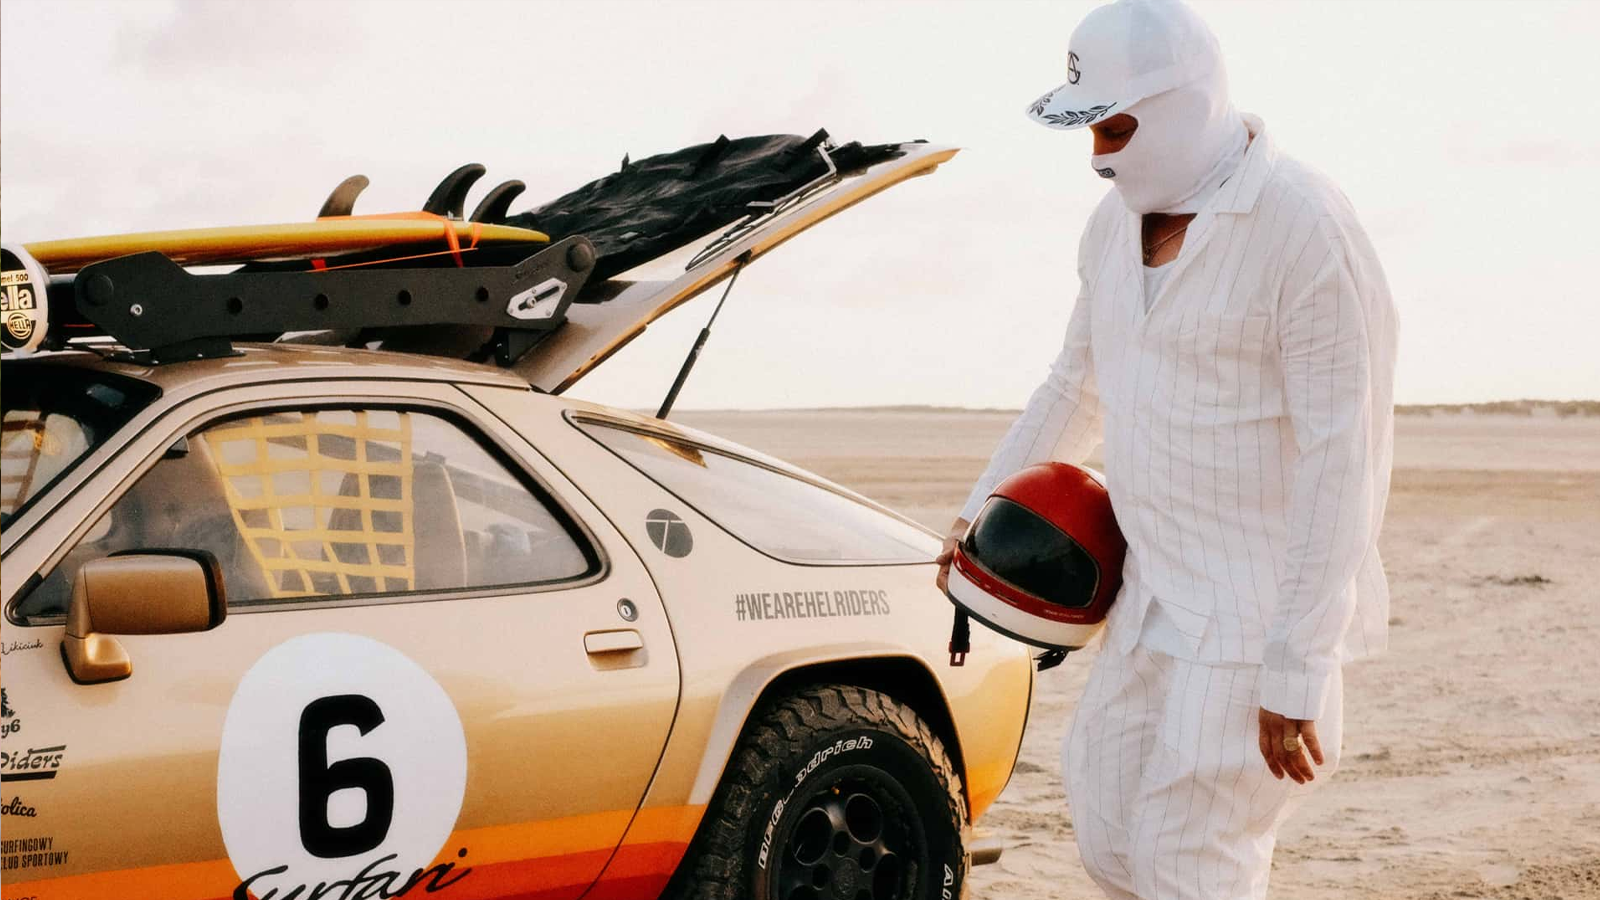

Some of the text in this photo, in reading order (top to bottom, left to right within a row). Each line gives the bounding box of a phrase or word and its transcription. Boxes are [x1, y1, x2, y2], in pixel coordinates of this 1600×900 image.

[9, 319, 31, 330] HELLA
[735, 589, 891, 621] #WEAREHELRIDERS
[298, 694, 394, 859] 6
[1, 796, 37, 817] olica
[758, 736, 874, 870] BFGodrich
[1, 851, 68, 870] LUB SPORTOWY
